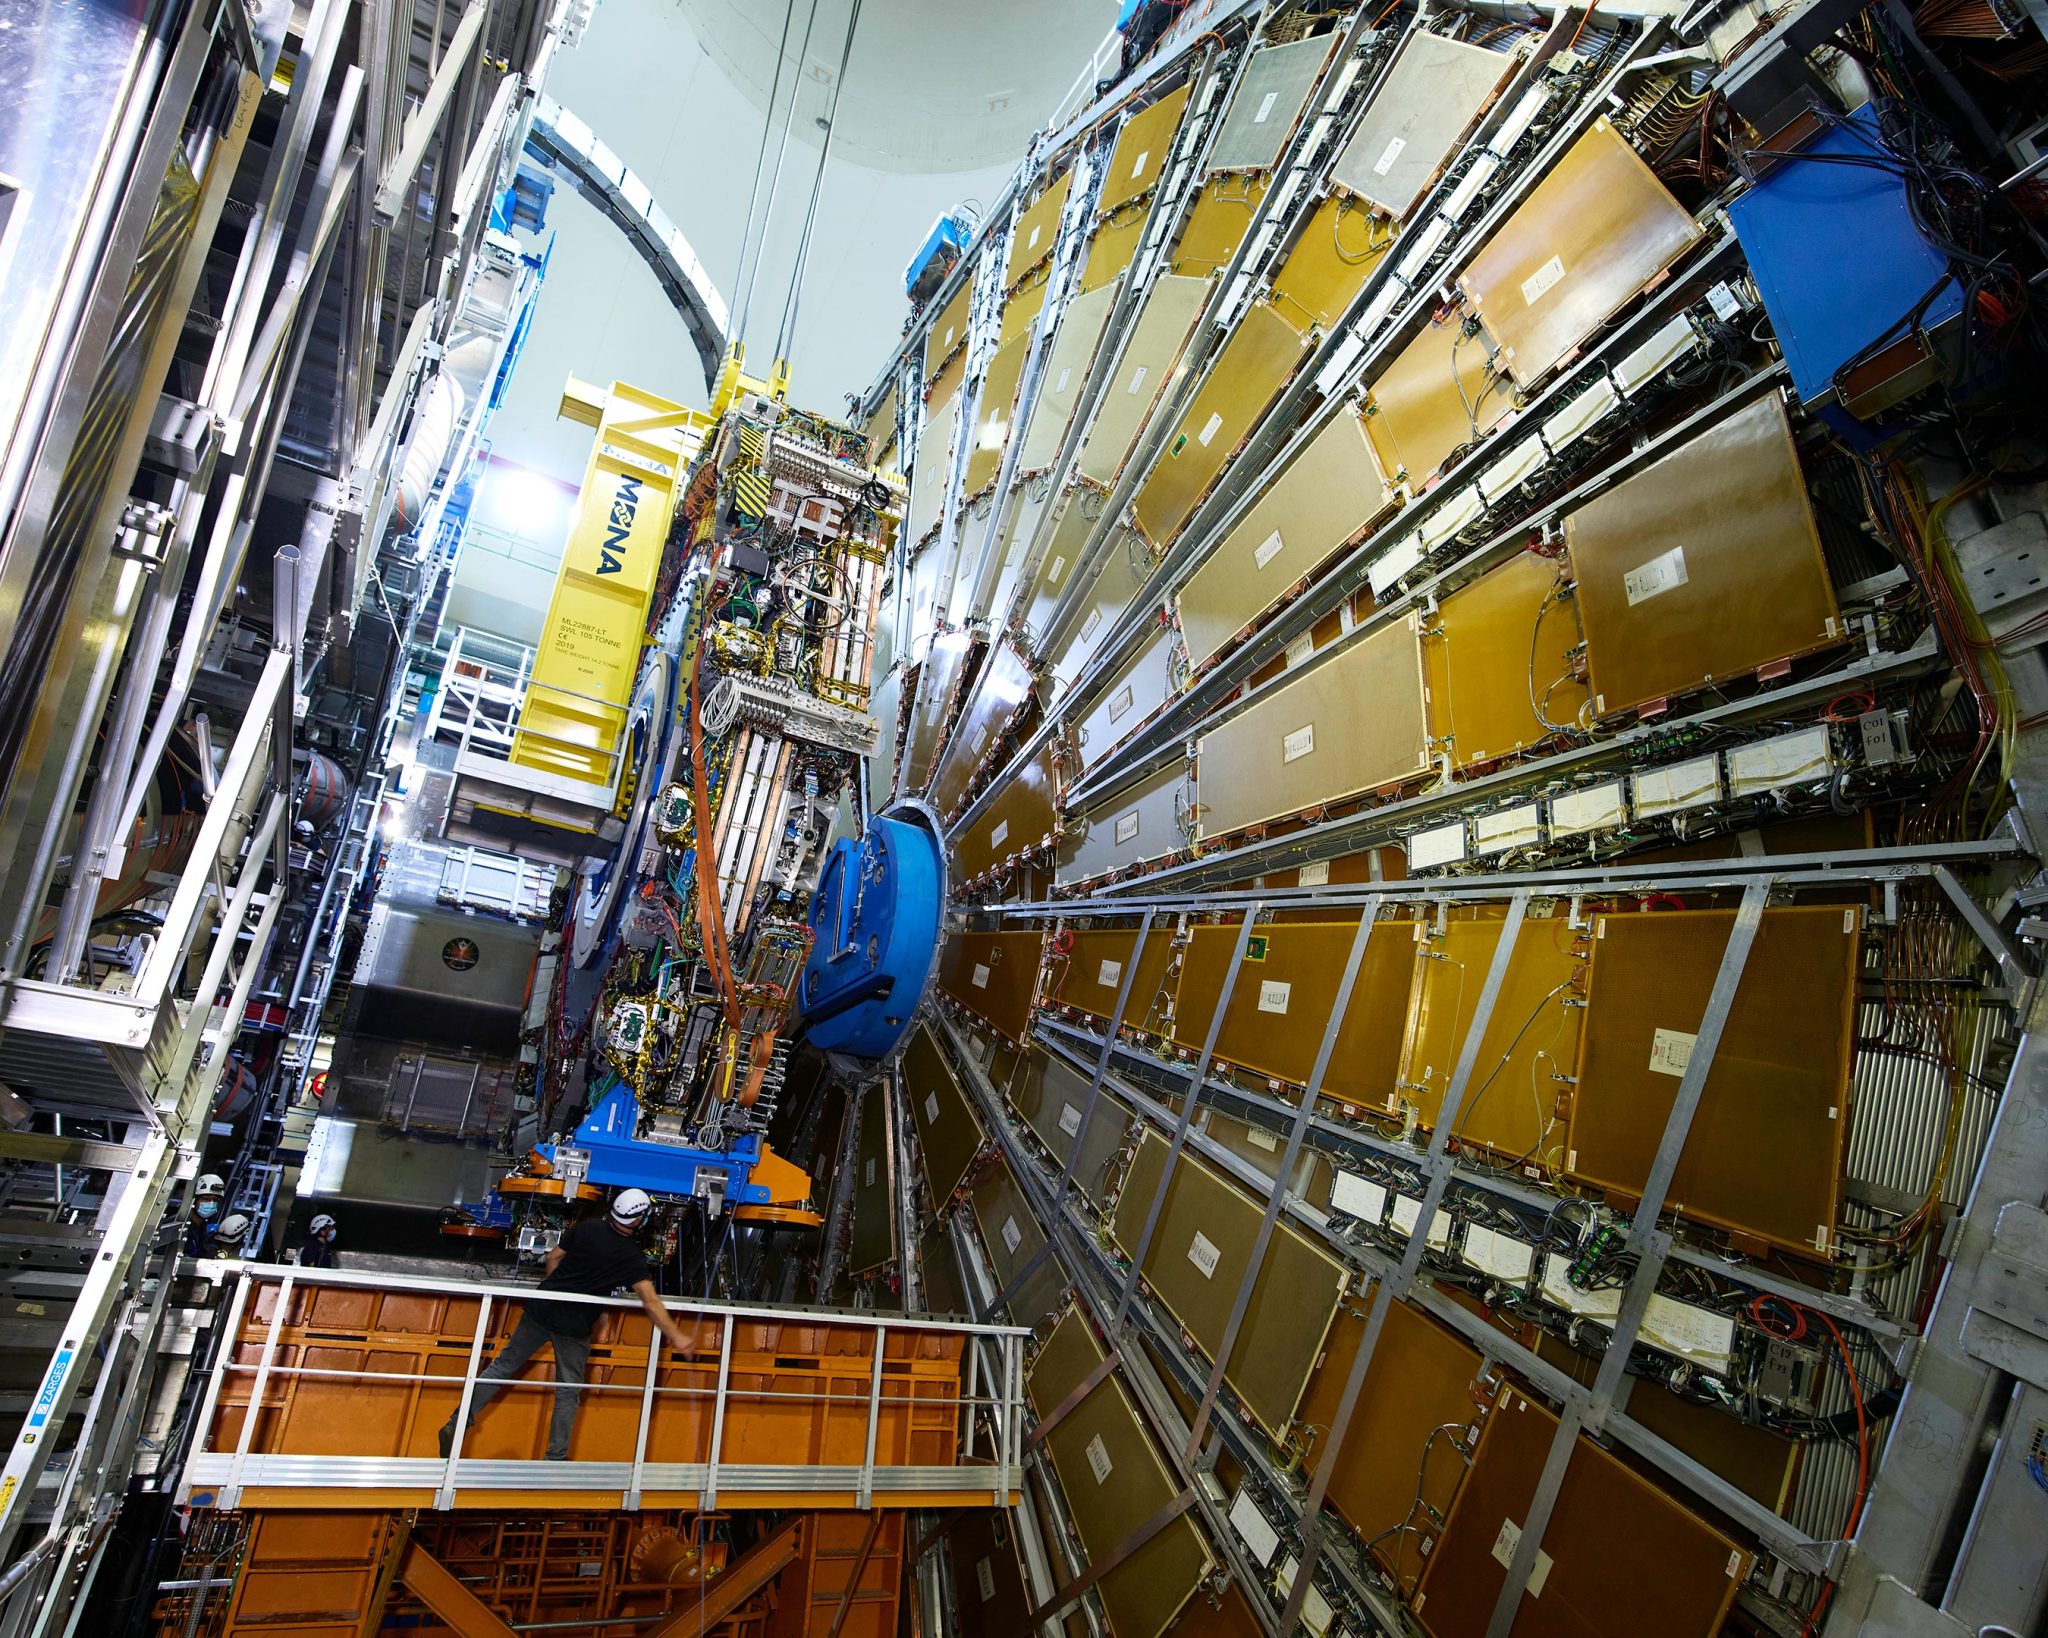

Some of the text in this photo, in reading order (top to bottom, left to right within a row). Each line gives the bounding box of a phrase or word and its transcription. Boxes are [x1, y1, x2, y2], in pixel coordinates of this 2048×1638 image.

[555, 639, 575, 650] 2019
[559, 625, 622, 649] SWL 105 TONNE
[41, 1362, 66, 1403] ZARGES
